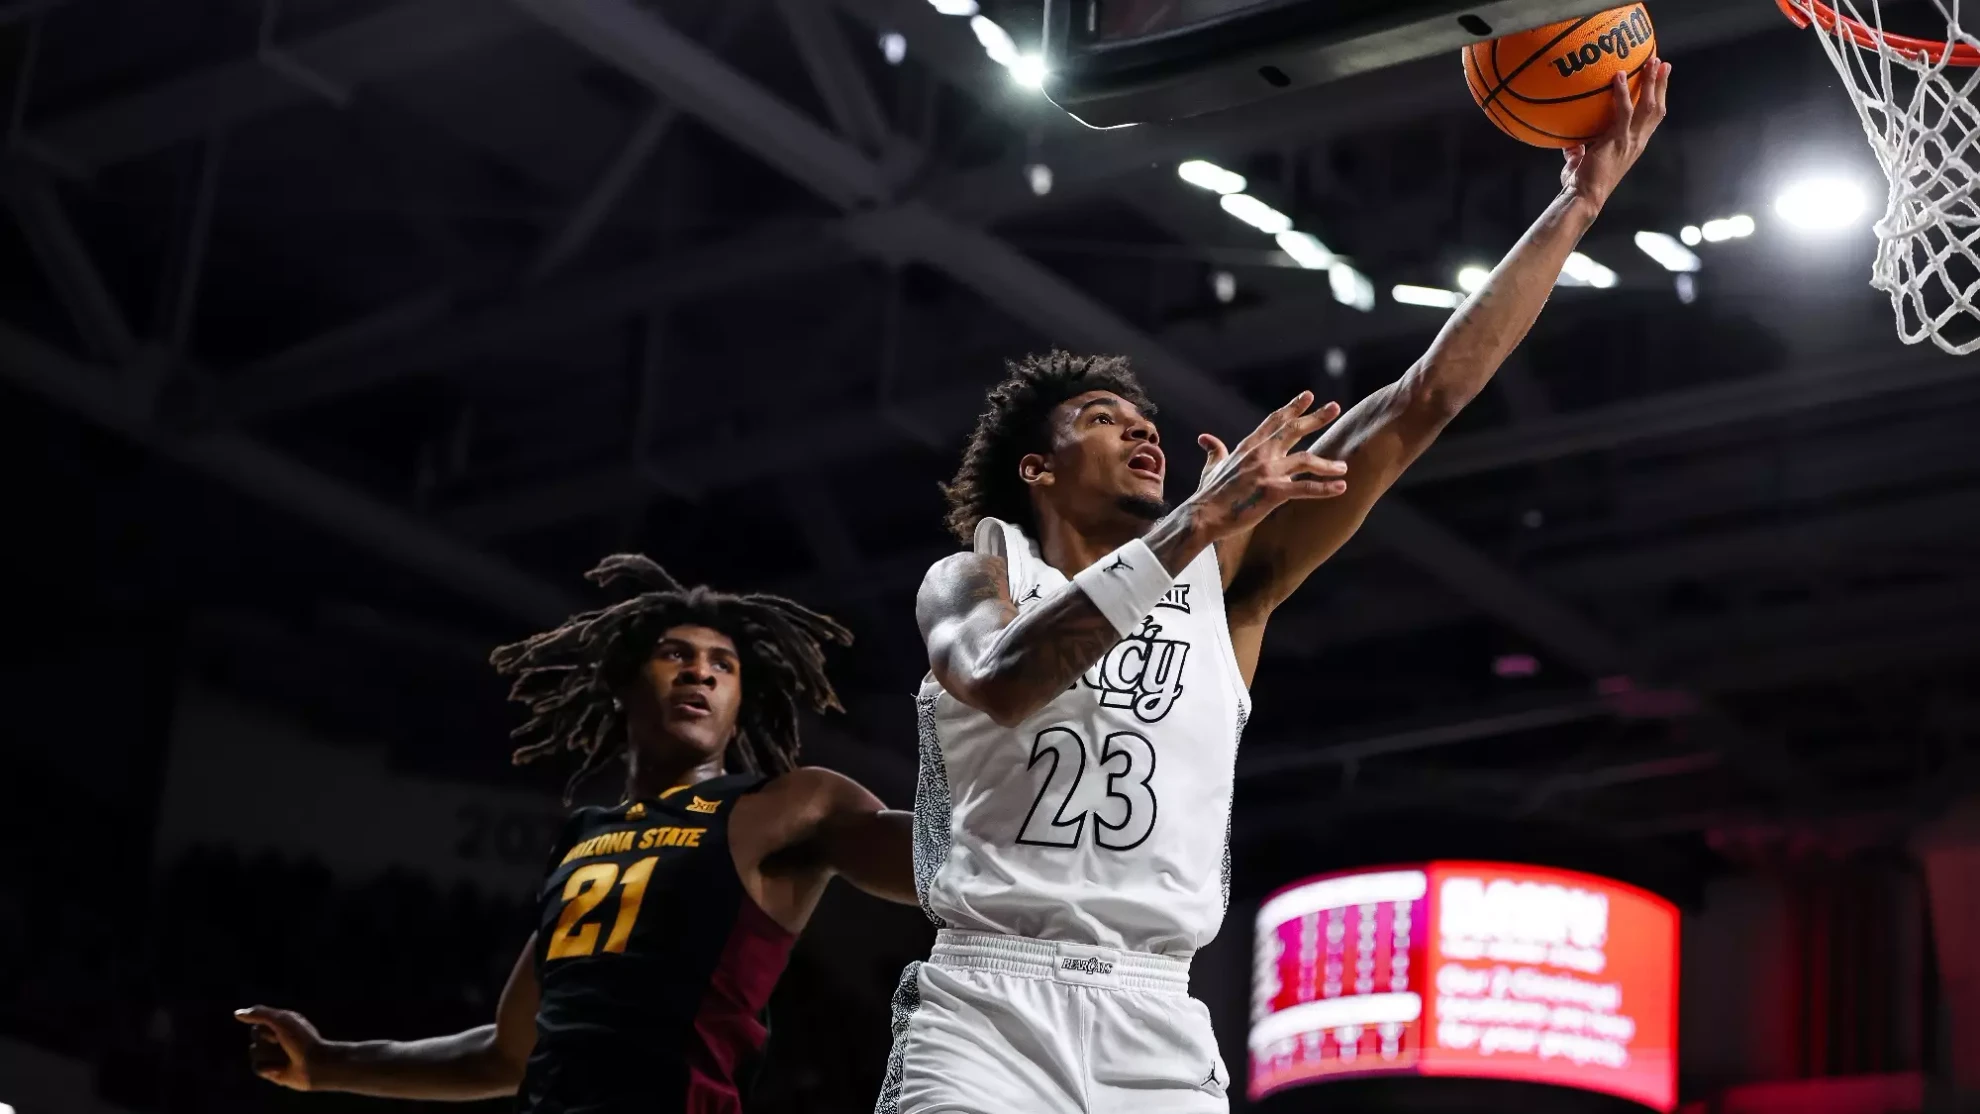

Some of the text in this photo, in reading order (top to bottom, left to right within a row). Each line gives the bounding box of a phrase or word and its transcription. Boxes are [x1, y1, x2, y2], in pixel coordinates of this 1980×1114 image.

[1551, 6, 1652, 78] Wilson
[1015, 726, 1157, 851] 23
[638, 826, 708, 850] STATE
[545, 855, 660, 961] 21
